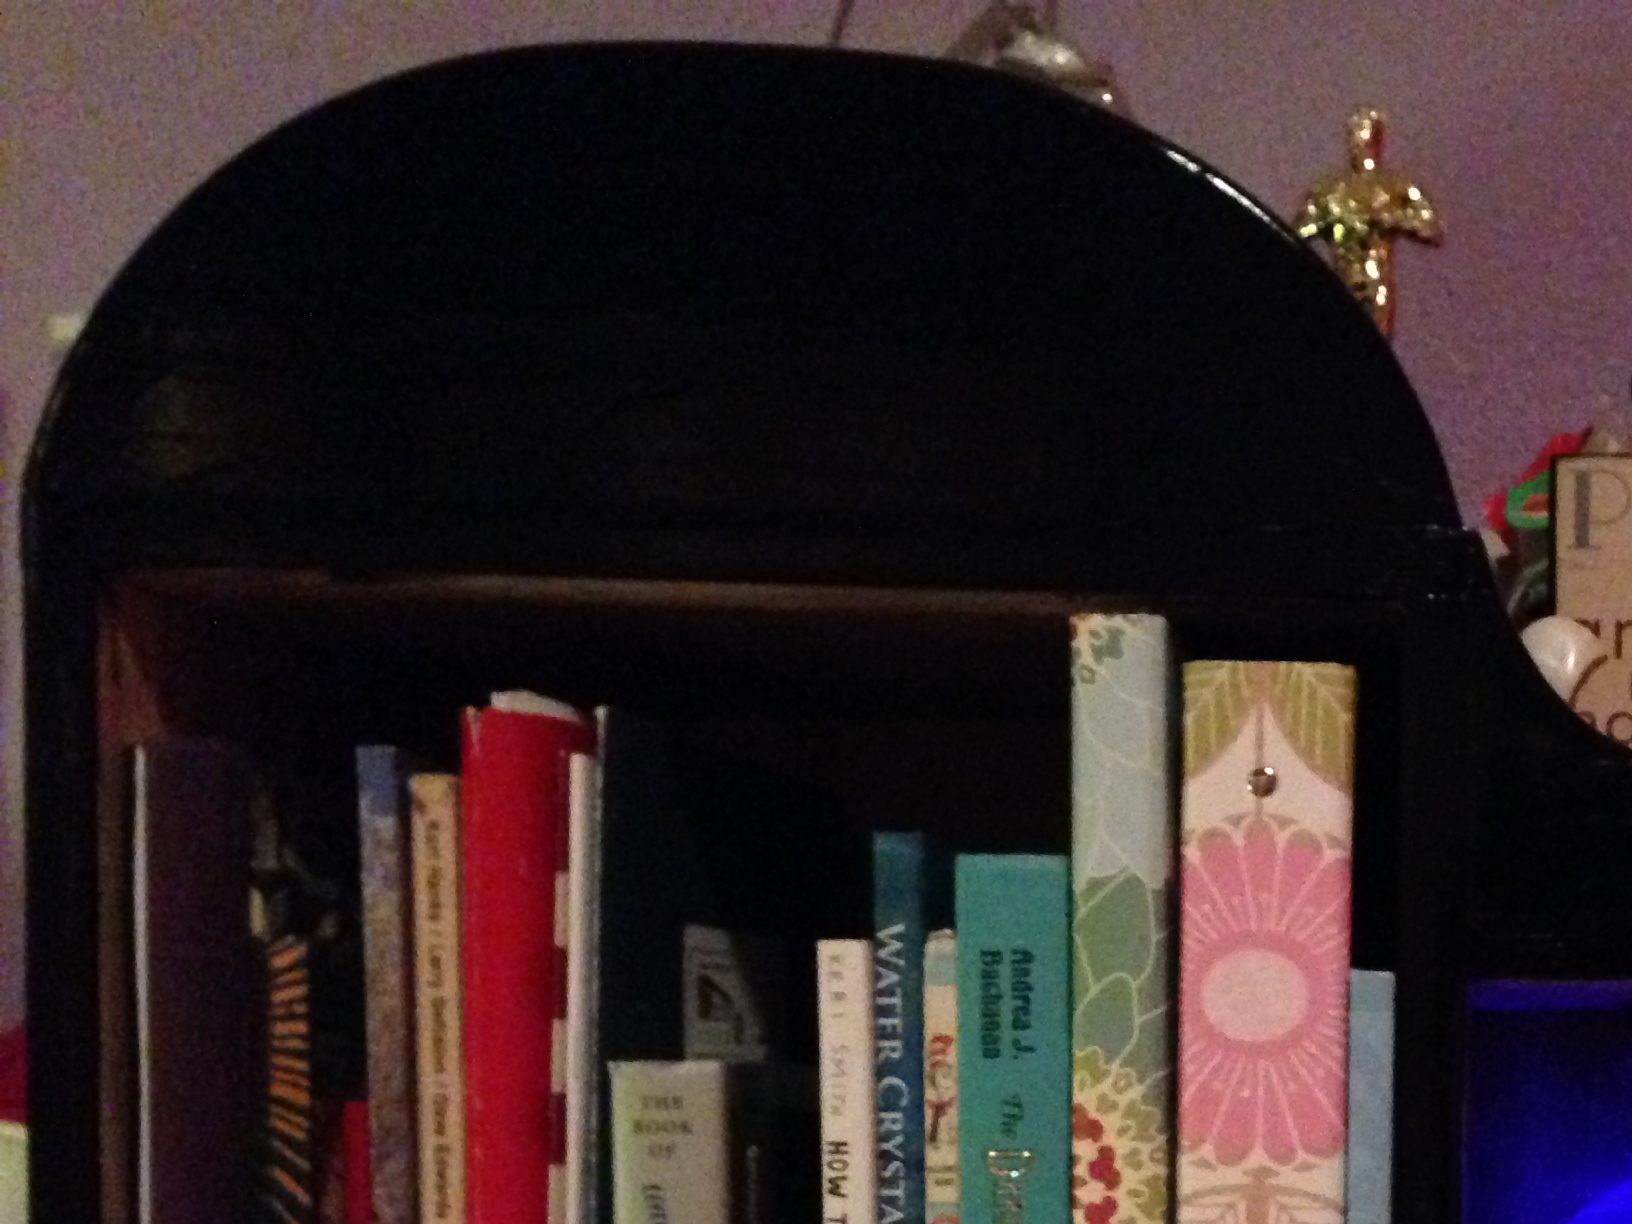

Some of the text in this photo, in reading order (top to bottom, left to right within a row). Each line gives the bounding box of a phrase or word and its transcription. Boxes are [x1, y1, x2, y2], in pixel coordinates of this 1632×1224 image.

[875, 923, 905, 1064] WATER
[979, 948, 1004, 1060] Buchanan
[1010, 948, 1037, 1060] Andrea J.
[826, 1140, 849, 1198] HOW
[1001, 1092, 1025, 1140] The
